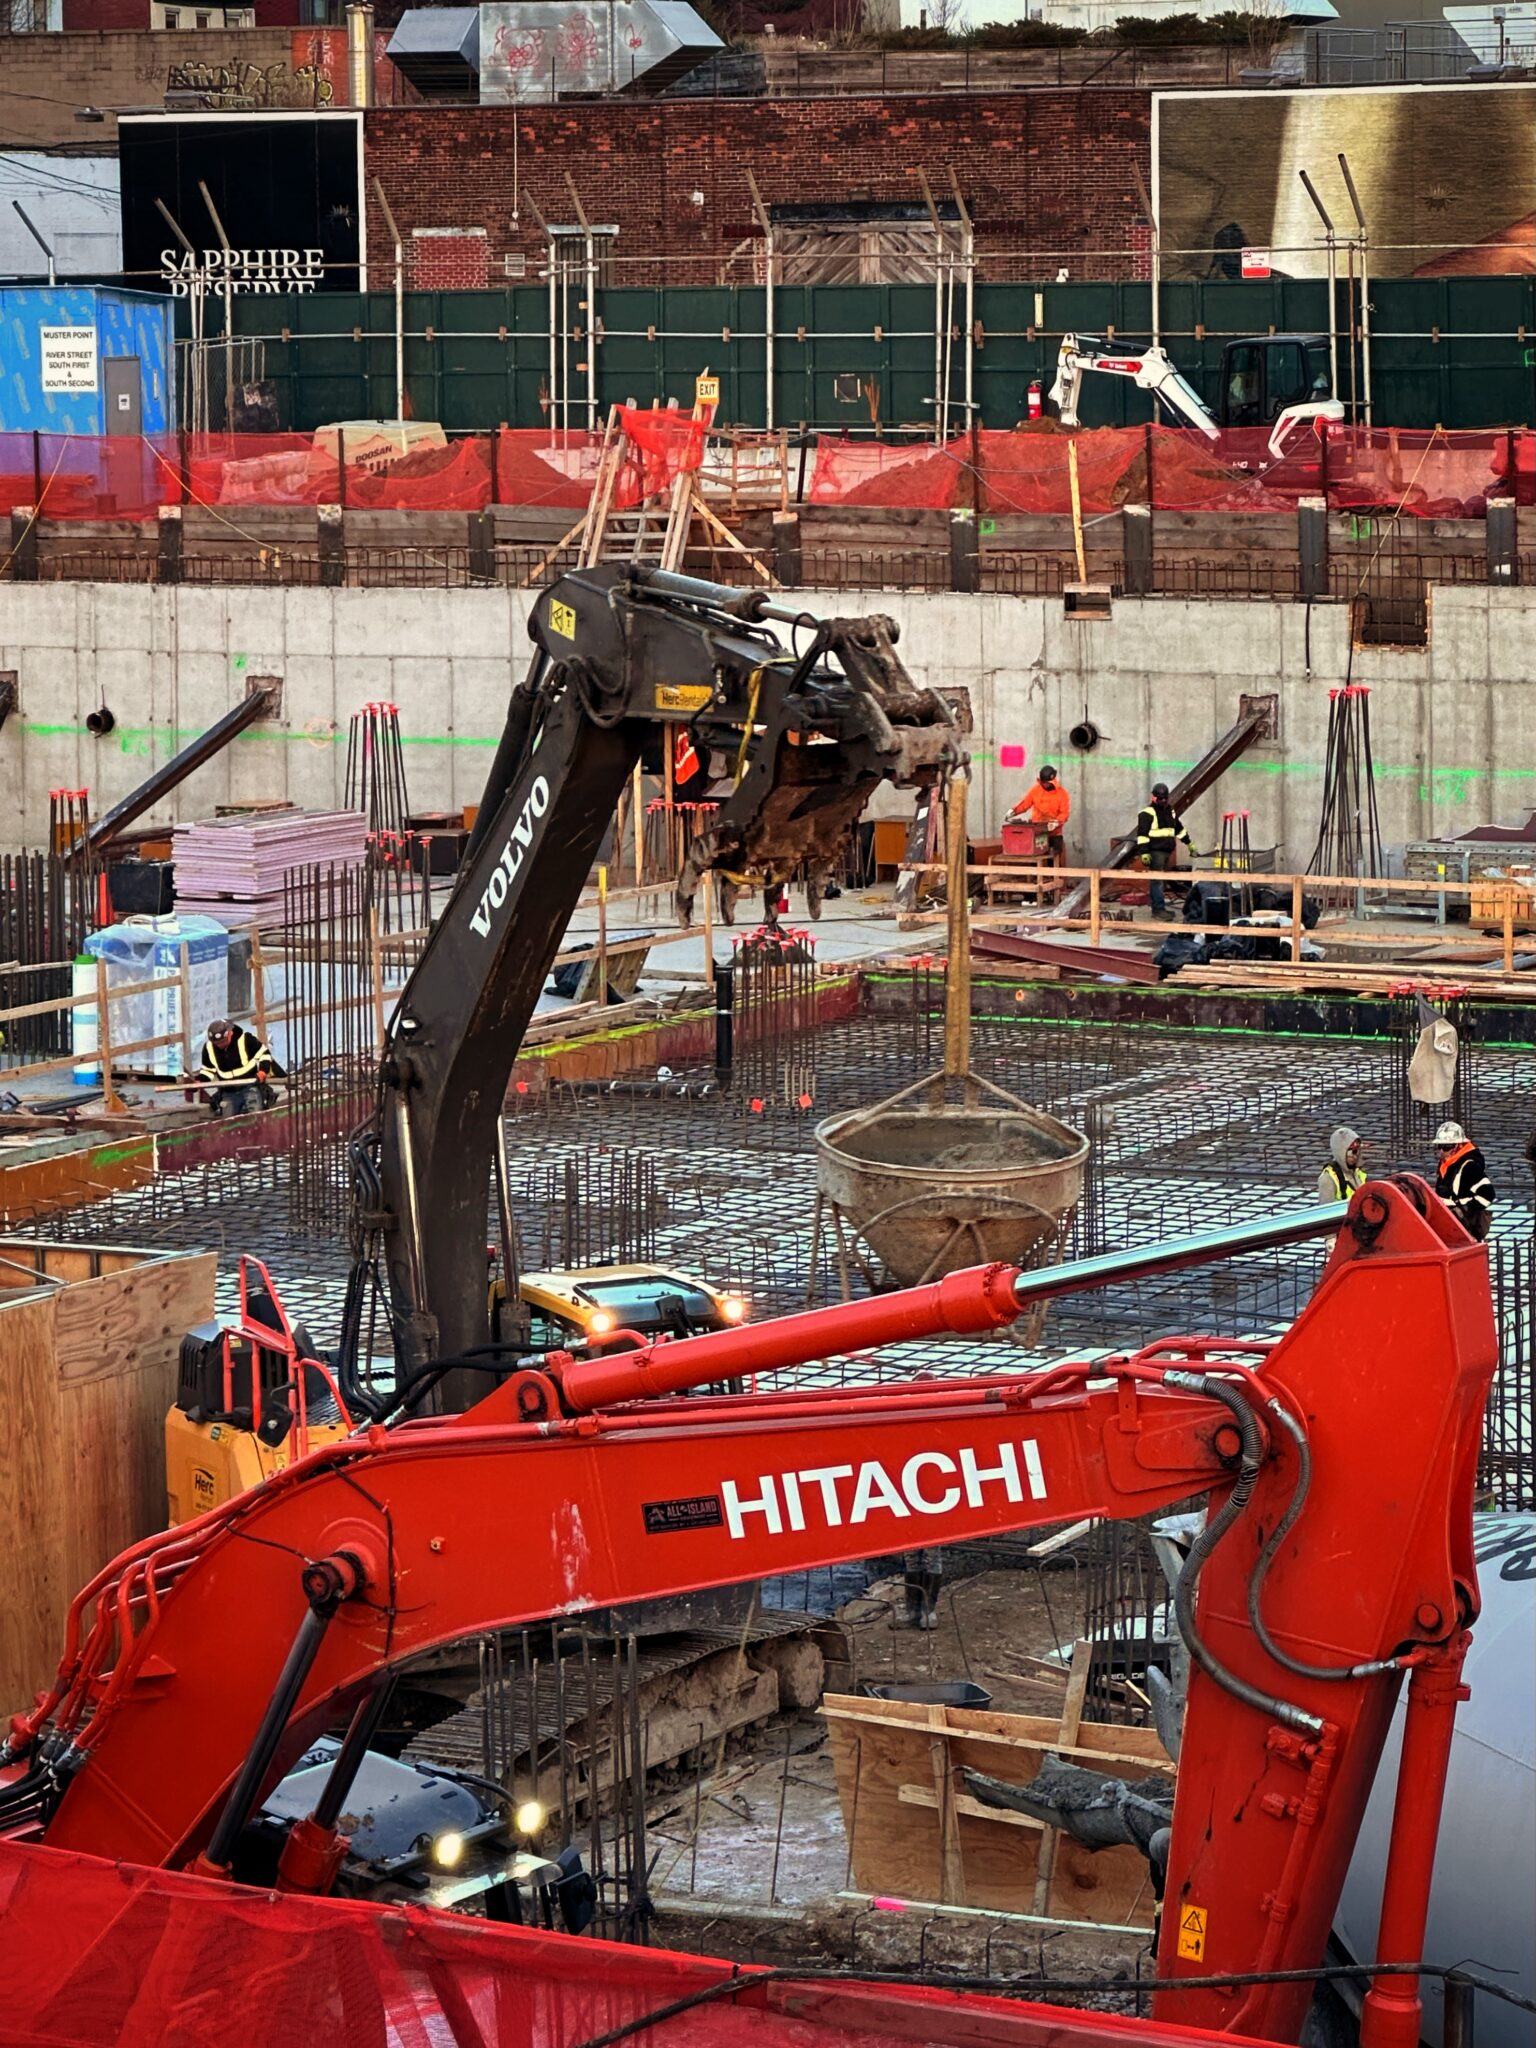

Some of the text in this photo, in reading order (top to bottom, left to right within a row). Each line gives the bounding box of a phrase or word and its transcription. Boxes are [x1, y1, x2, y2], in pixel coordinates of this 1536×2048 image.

[160, 249, 325, 279] SAPPHIRE
[171, 281, 316, 295] RSERVE
[43, 331, 93, 339] MUSTER POINT
[45, 351, 93, 359] RIVER STREET
[48, 361, 90, 369] SOUTH FIRST
[700, 383, 715, 396] EXIT
[469, 776, 550, 938] VOLVO
[195, 1473, 214, 1495] Herc
[721, 1439, 1048, 1539] HITACHI
[666, 1500, 718, 1518] ALL ISLAND
